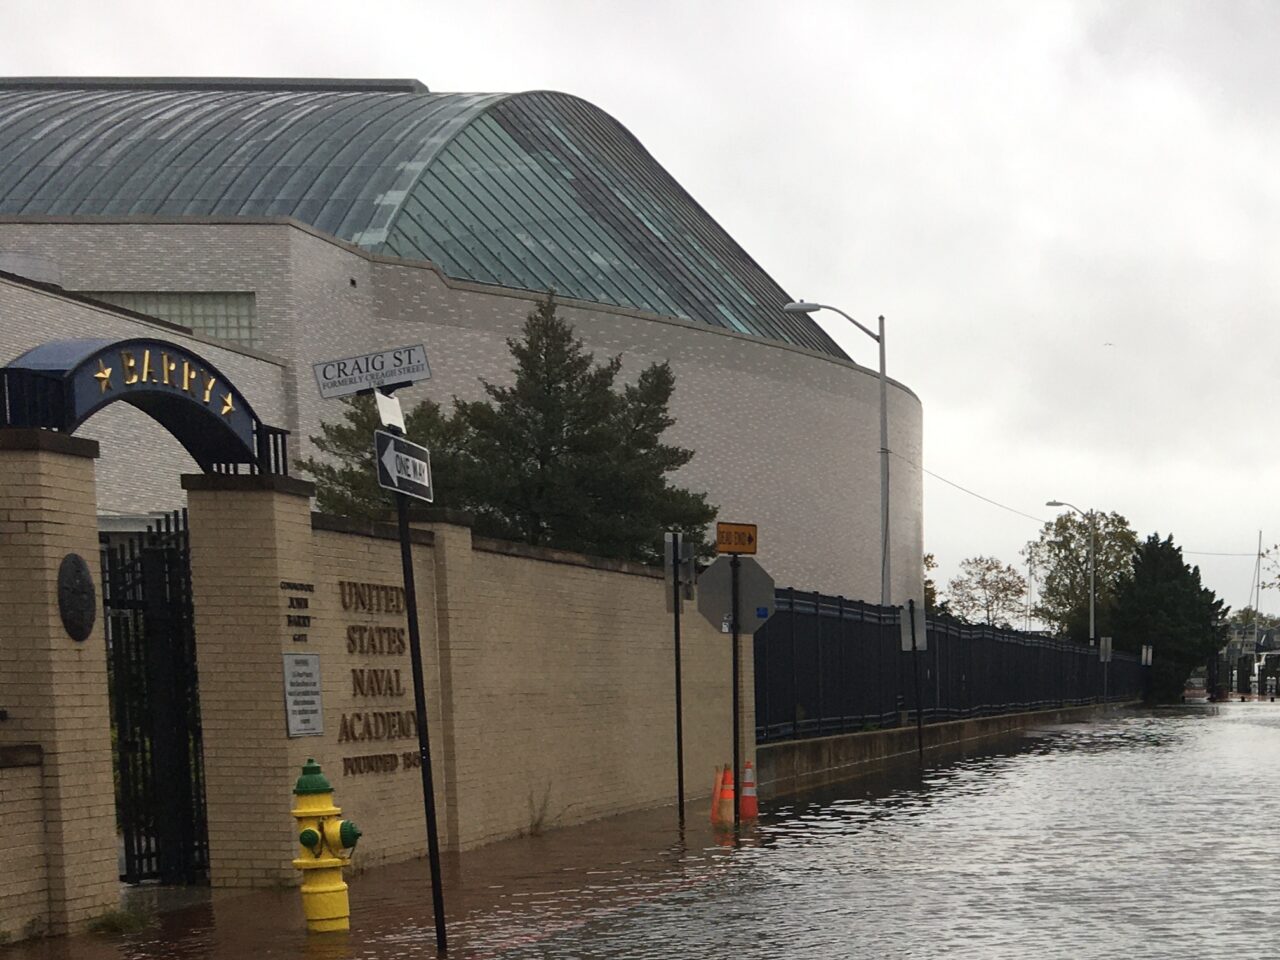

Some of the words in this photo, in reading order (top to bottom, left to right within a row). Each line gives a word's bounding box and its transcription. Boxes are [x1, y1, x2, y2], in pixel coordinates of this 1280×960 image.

[121, 349, 216, 403] BARRY
[322, 354, 384, 380] CRAIG
[393, 348, 421, 368] ST.
[322, 375, 363, 390] FORMERLY
[397, 363, 425, 376] STREET
[395, 454, 411, 478] ONE
[411, 459, 426, 483] WAY
[734, 531, 747, 546] END
[338, 581, 406, 613] UNITED
[346, 626, 406, 655] STATES
[351, 668, 406, 697] NAVAL
